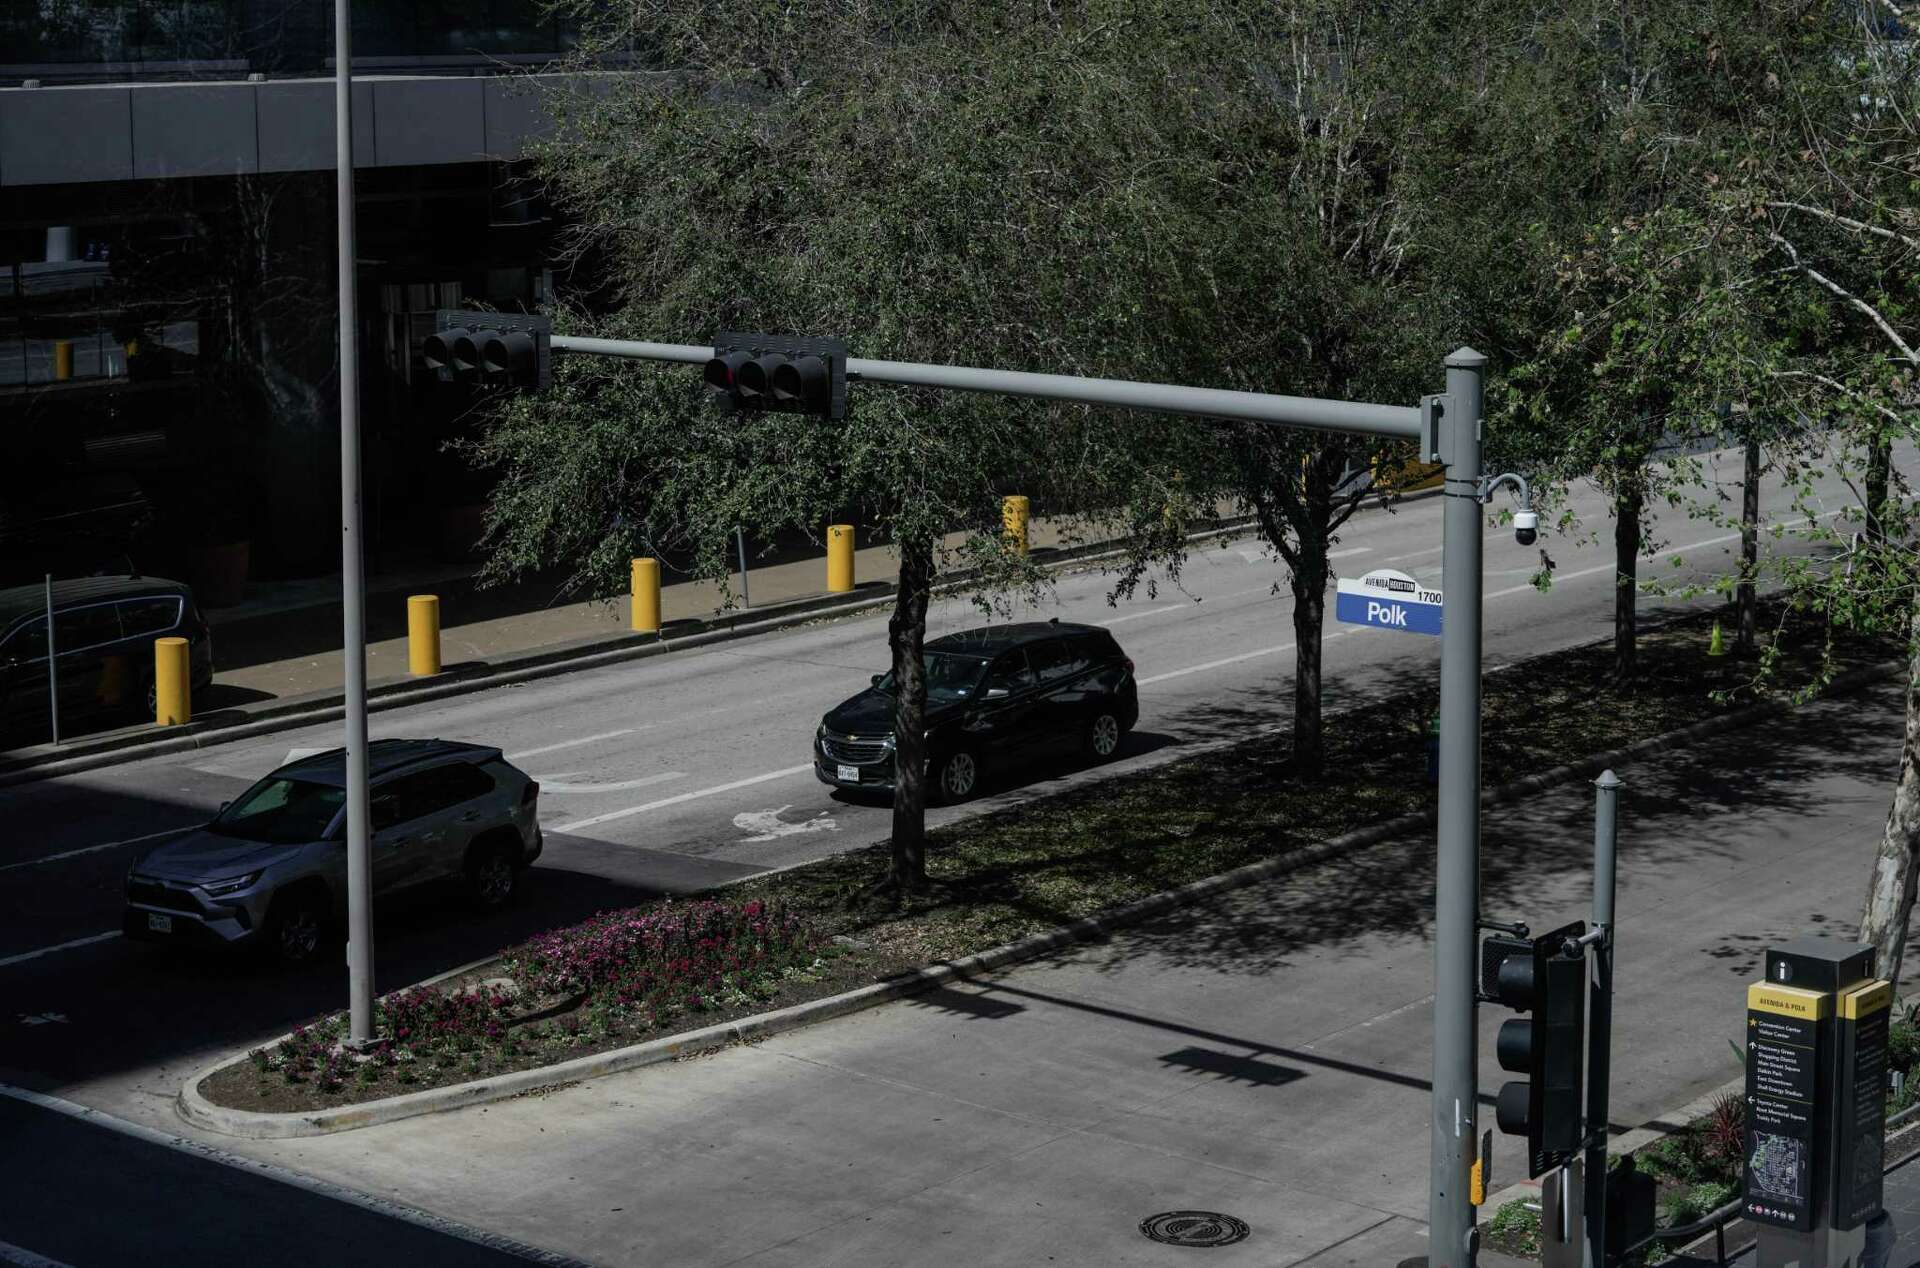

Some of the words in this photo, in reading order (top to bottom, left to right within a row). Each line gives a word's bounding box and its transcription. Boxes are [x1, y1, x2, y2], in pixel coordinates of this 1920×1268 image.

[1365, 578, 1388, 588] AVENIDA
[1418, 591, 1441, 603] 1700
[1368, 602, 1407, 626] Polk
[1785, 1025, 1801, 1033] Center
